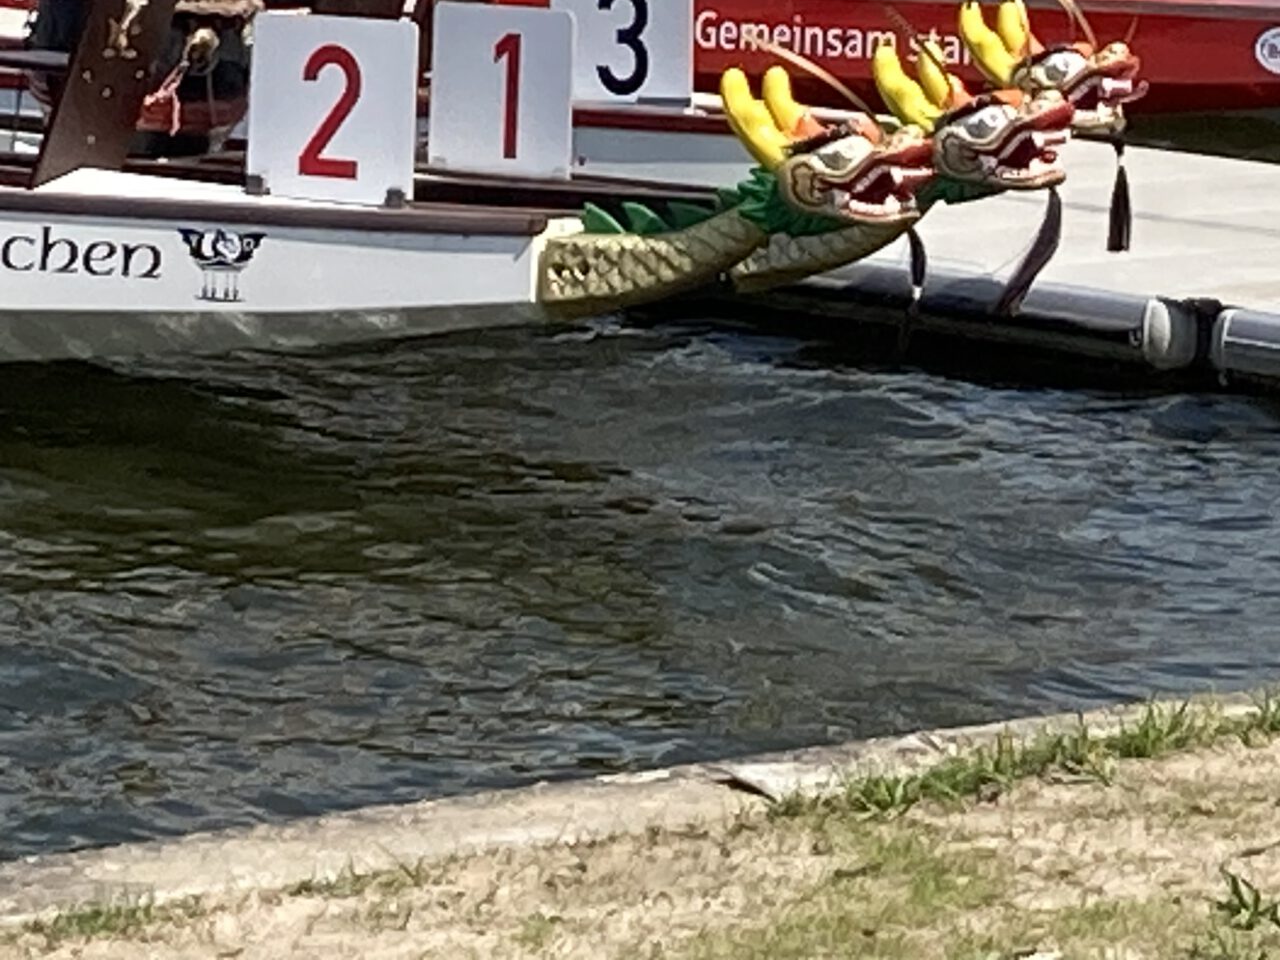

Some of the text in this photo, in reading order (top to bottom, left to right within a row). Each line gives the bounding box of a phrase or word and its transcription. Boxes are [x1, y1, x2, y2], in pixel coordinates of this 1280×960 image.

[695, 11, 897, 59] Gemeinsam
[298, 44, 361, 180] 2
[493, 33, 522, 160] 1
[1, 226, 162, 279] chen
